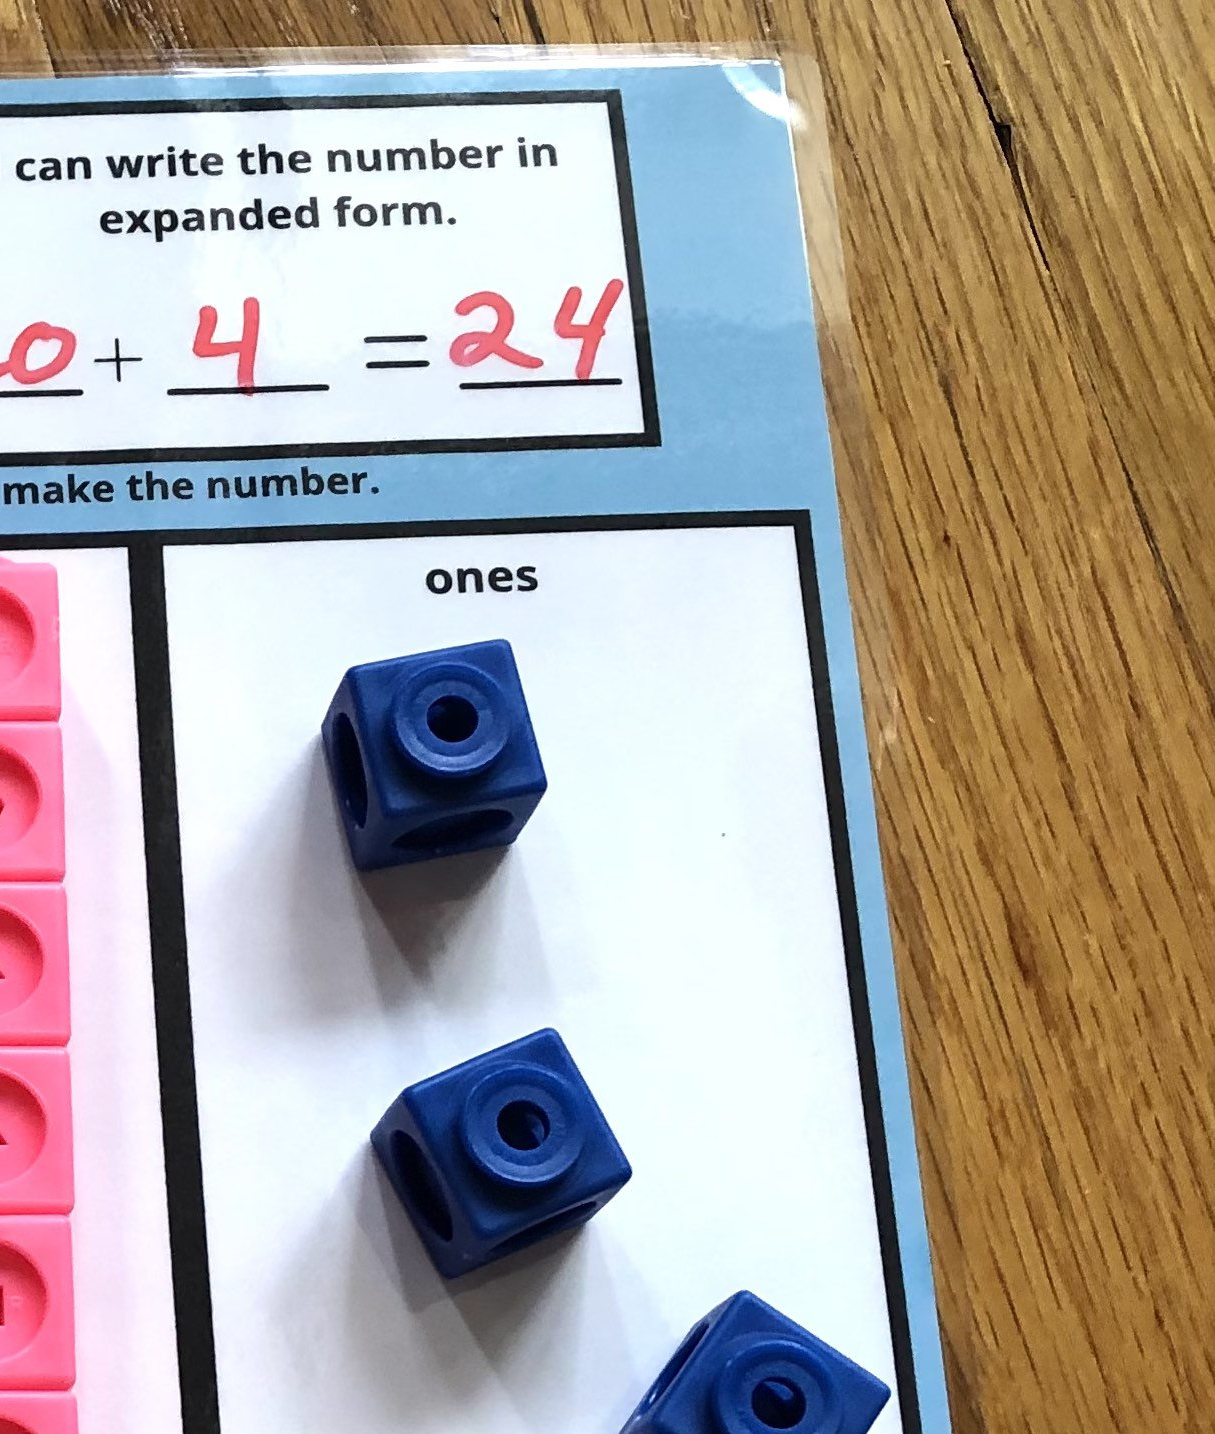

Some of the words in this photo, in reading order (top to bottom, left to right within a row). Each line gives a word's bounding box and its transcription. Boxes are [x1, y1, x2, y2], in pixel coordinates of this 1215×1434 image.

[15, 156, 92, 182] can
[106, 145, 224, 179] write
[236, 143, 312, 176] the
[327, 138, 504, 173] number
[517, 136, 558, 168] in
[99, 196, 320, 243] expanded
[333, 195, 457, 228] form.
[192, 297, 260, 395] 4
[448, 278, 624, 381] 24
[3, 472, 115, 505] make
[125, 471, 193, 501] the
[207, 467, 380, 499] number.
[425, 565, 538, 595] ones
